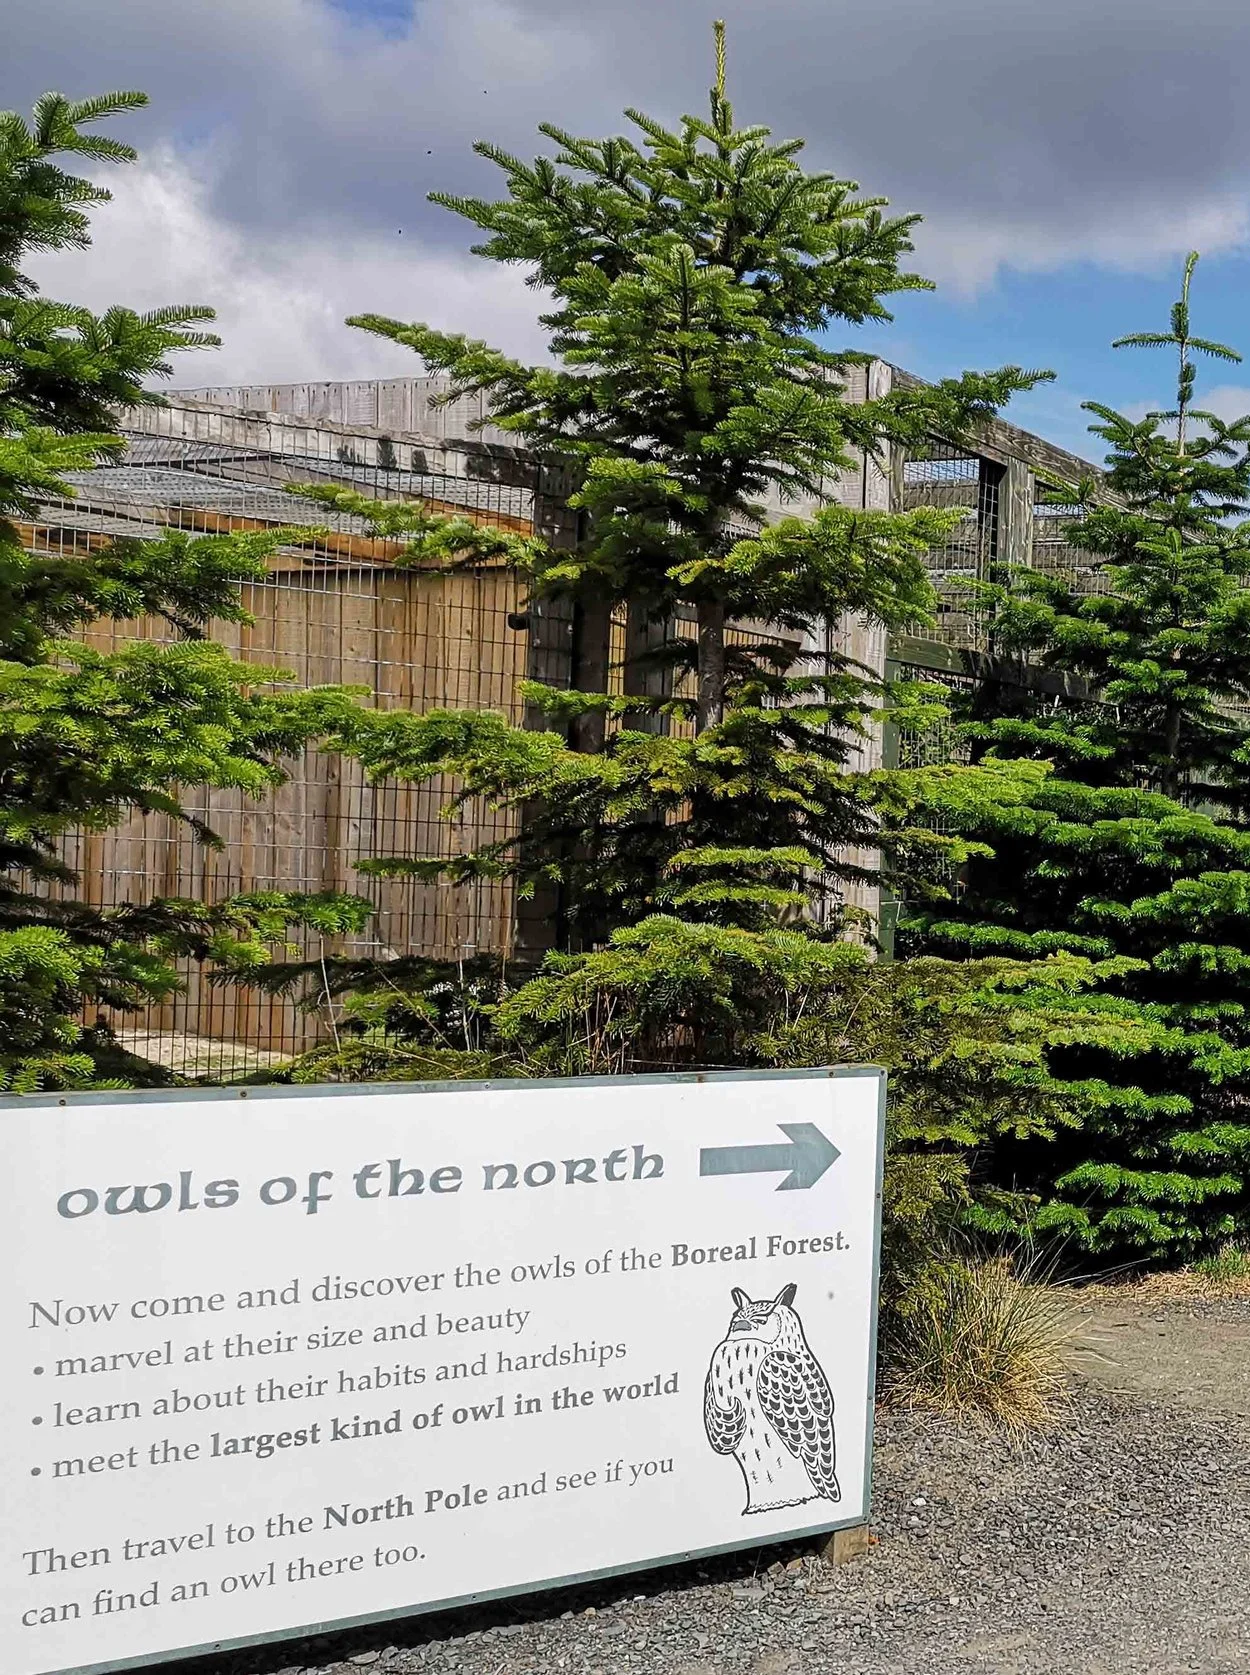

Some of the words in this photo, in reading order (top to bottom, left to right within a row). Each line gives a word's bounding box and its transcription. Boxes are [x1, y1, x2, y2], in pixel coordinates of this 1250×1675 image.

[56, 1170, 240, 1219] owls
[259, 1170, 334, 1216] of
[352, 1158, 463, 1199] the
[27, 1299, 120, 1329] Now
[130, 1293, 225, 1319] come
[236, 1278, 301, 1310] and
[311, 1273, 445, 1302] discover
[453, 1262, 501, 1289] the
[510, 1254, 576, 1283] owls
[584, 1249, 613, 1275] of
[619, 1247, 662, 1272] the
[670, 1236, 758, 1267] Boreal
[765, 1230, 850, 1258] Forest.
[53, 1401, 142, 1428] learn
[152, 1384, 247, 1416] about
[255, 1374, 329, 1404] their
[337, 1364, 426, 1394] habits
[435, 1352, 489, 1382] and
[496, 1340, 627, 1374] hardships
[55, 1340, 174, 1377] marvel
[184, 1339, 214, 1363] at
[223, 1330, 298, 1359] their
[306, 1325, 363, 1350] size
[373, 1314, 428, 1343] and
[435, 1307, 531, 1336] beauty
[52, 1446, 139, 1478] meet
[148, 1438, 200, 1465] the
[210, 1422, 321, 1459] largest
[329, 1408, 403, 1442] kind
[412, 1403, 444, 1430] of
[451, 1395, 505, 1425] owl
[513, 1393, 543, 1416] in
[551, 1386, 594, 1411] the
[602, 1371, 680, 1403] world
[22, 1547, 112, 1576] Then
[122, 1523, 216, 1561] travel
[225, 1523, 255, 1545] to
[265, 1512, 314, 1539] the
[322, 1494, 415, 1530] North
[423, 1483, 488, 1514] Pole
[497, 1471, 548, 1501] and
[555, 1470, 597, 1492] see
[604, 1459, 624, 1484] if
[628, 1457, 674, 1487] you
[21, 1602, 82, 1627] can
[91, 1580, 160, 1616] find
[170, 1581, 210, 1602] an
[220, 1561, 276, 1594] owl
[285, 1555, 364, 1583] there
[373, 1545, 426, 1568] too.
